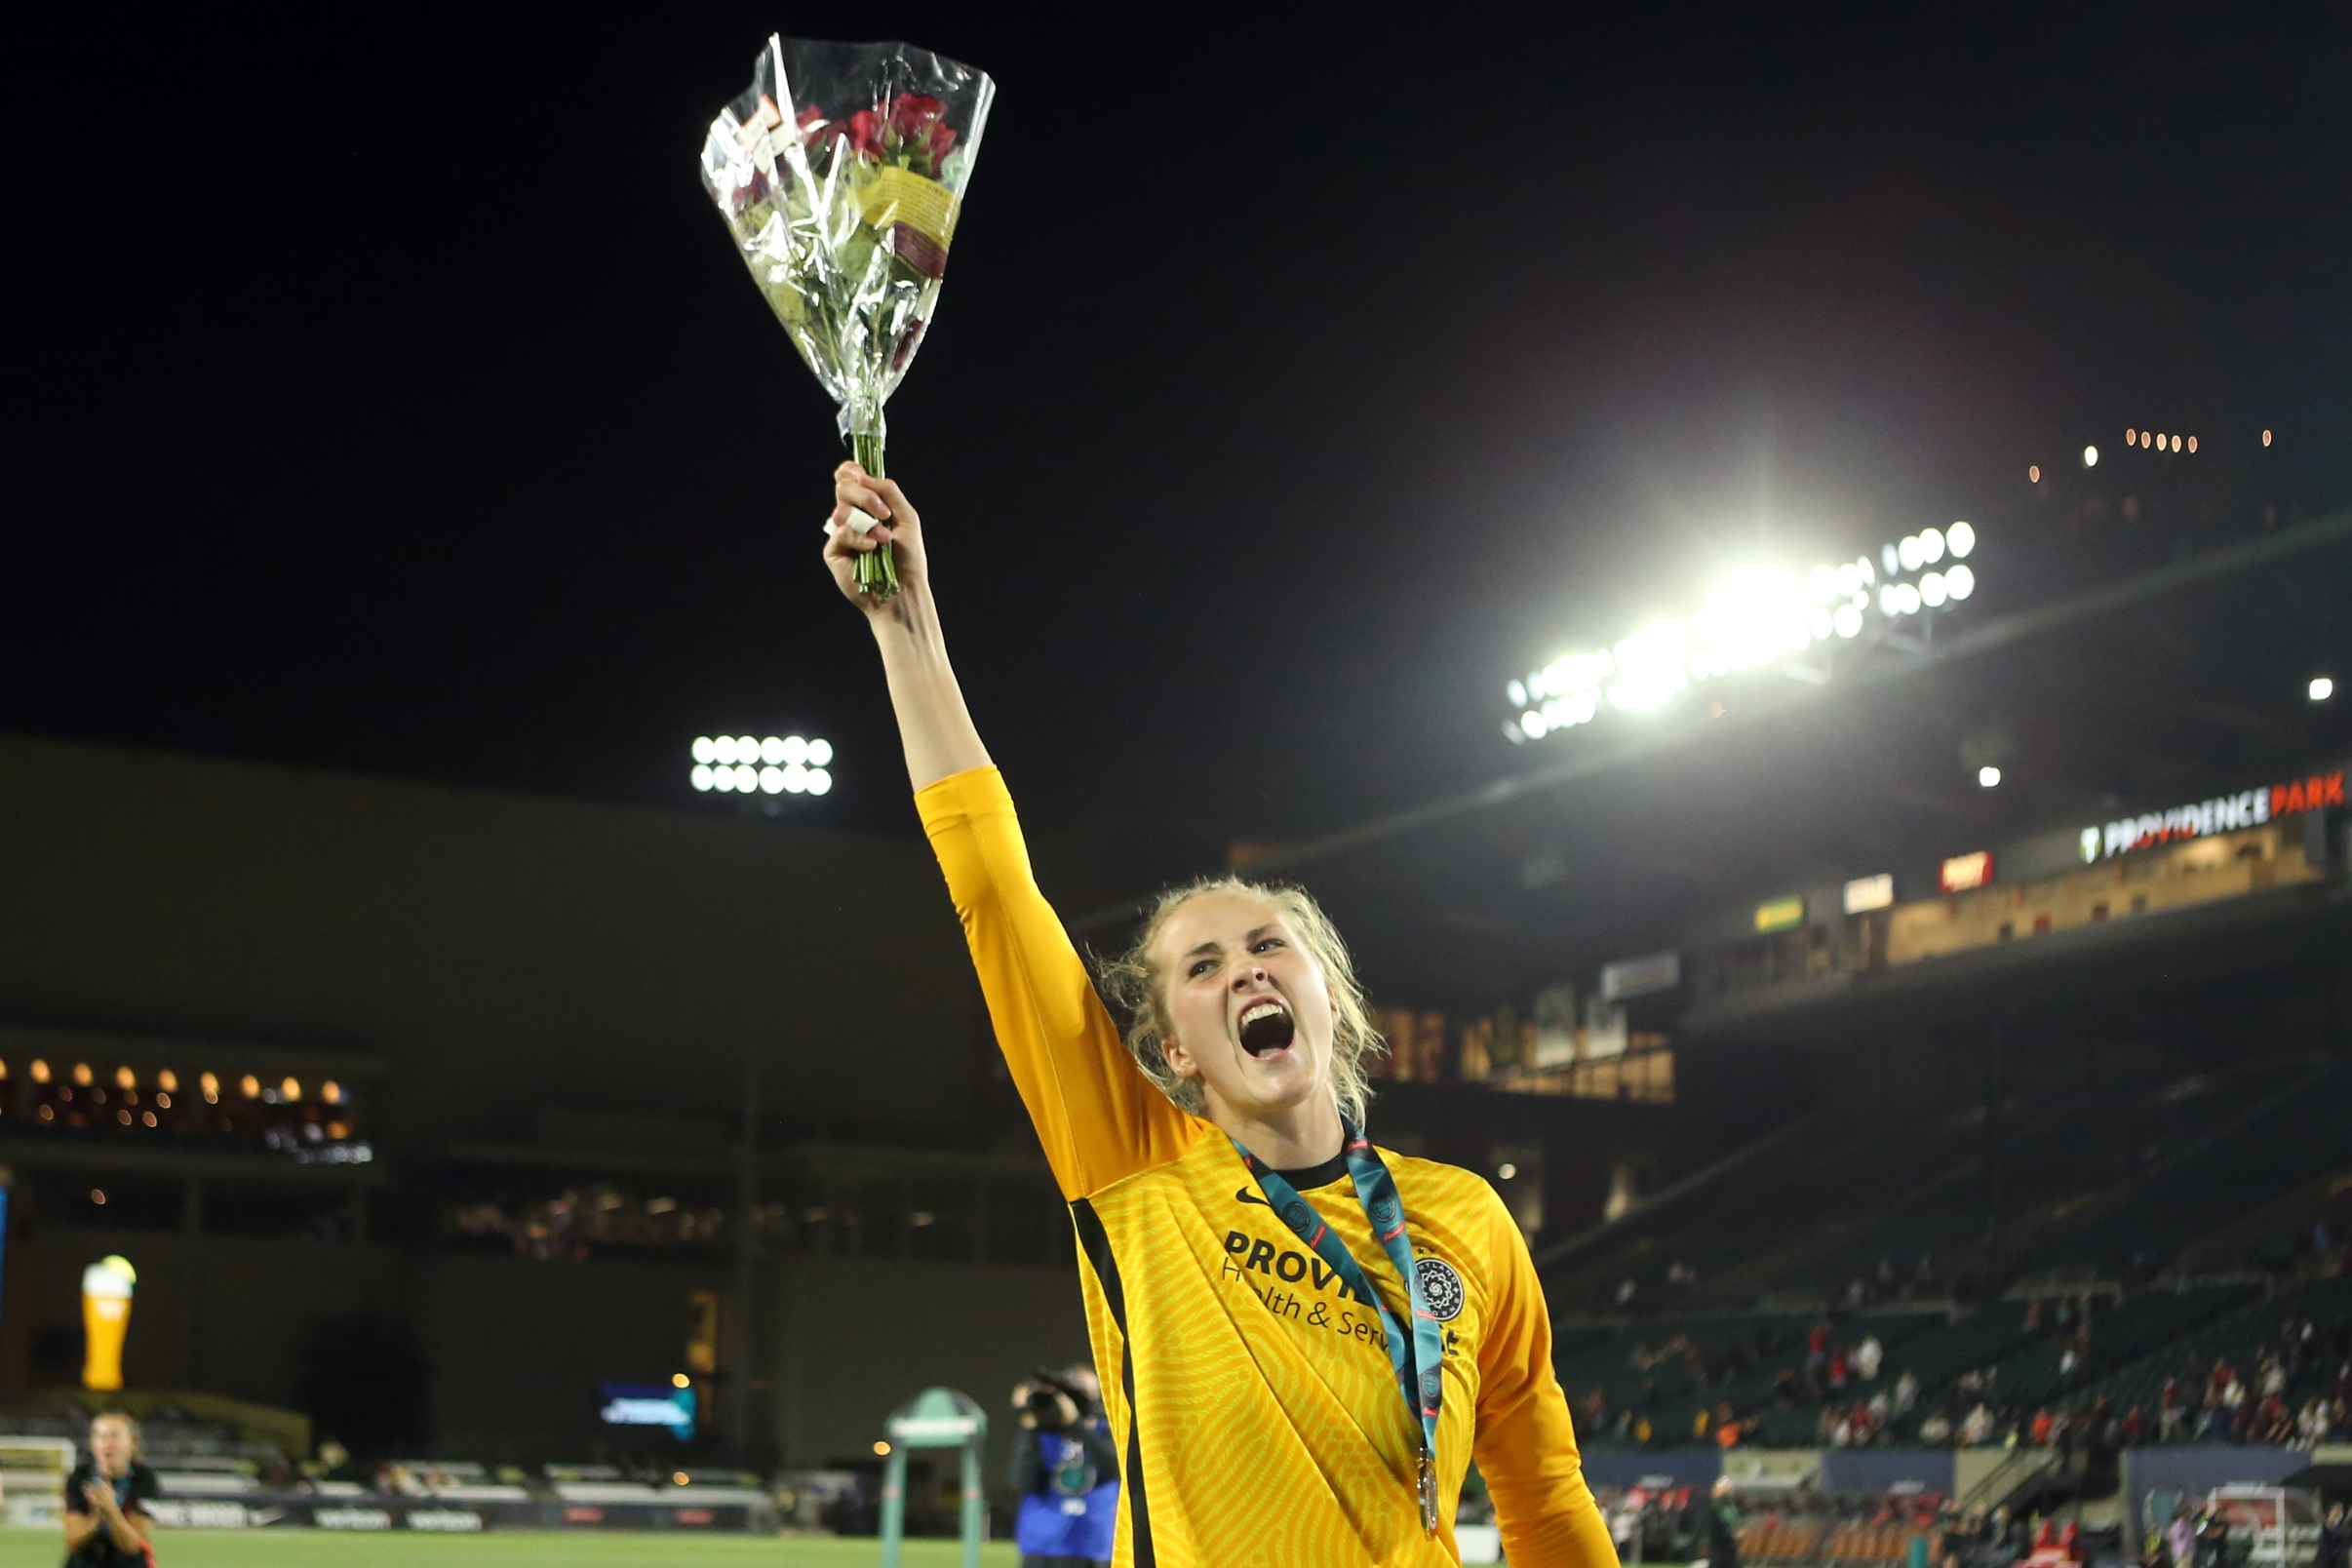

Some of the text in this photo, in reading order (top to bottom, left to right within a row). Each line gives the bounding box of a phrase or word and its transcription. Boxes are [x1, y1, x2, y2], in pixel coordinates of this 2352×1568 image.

[2104, 770, 2344, 858] PROVIDENCE PARK
[1222, 1257, 1301, 1319] Halth
[1307, 1302, 1330, 1328] &
[1418, 1262, 1458, 1284] RTLAND
